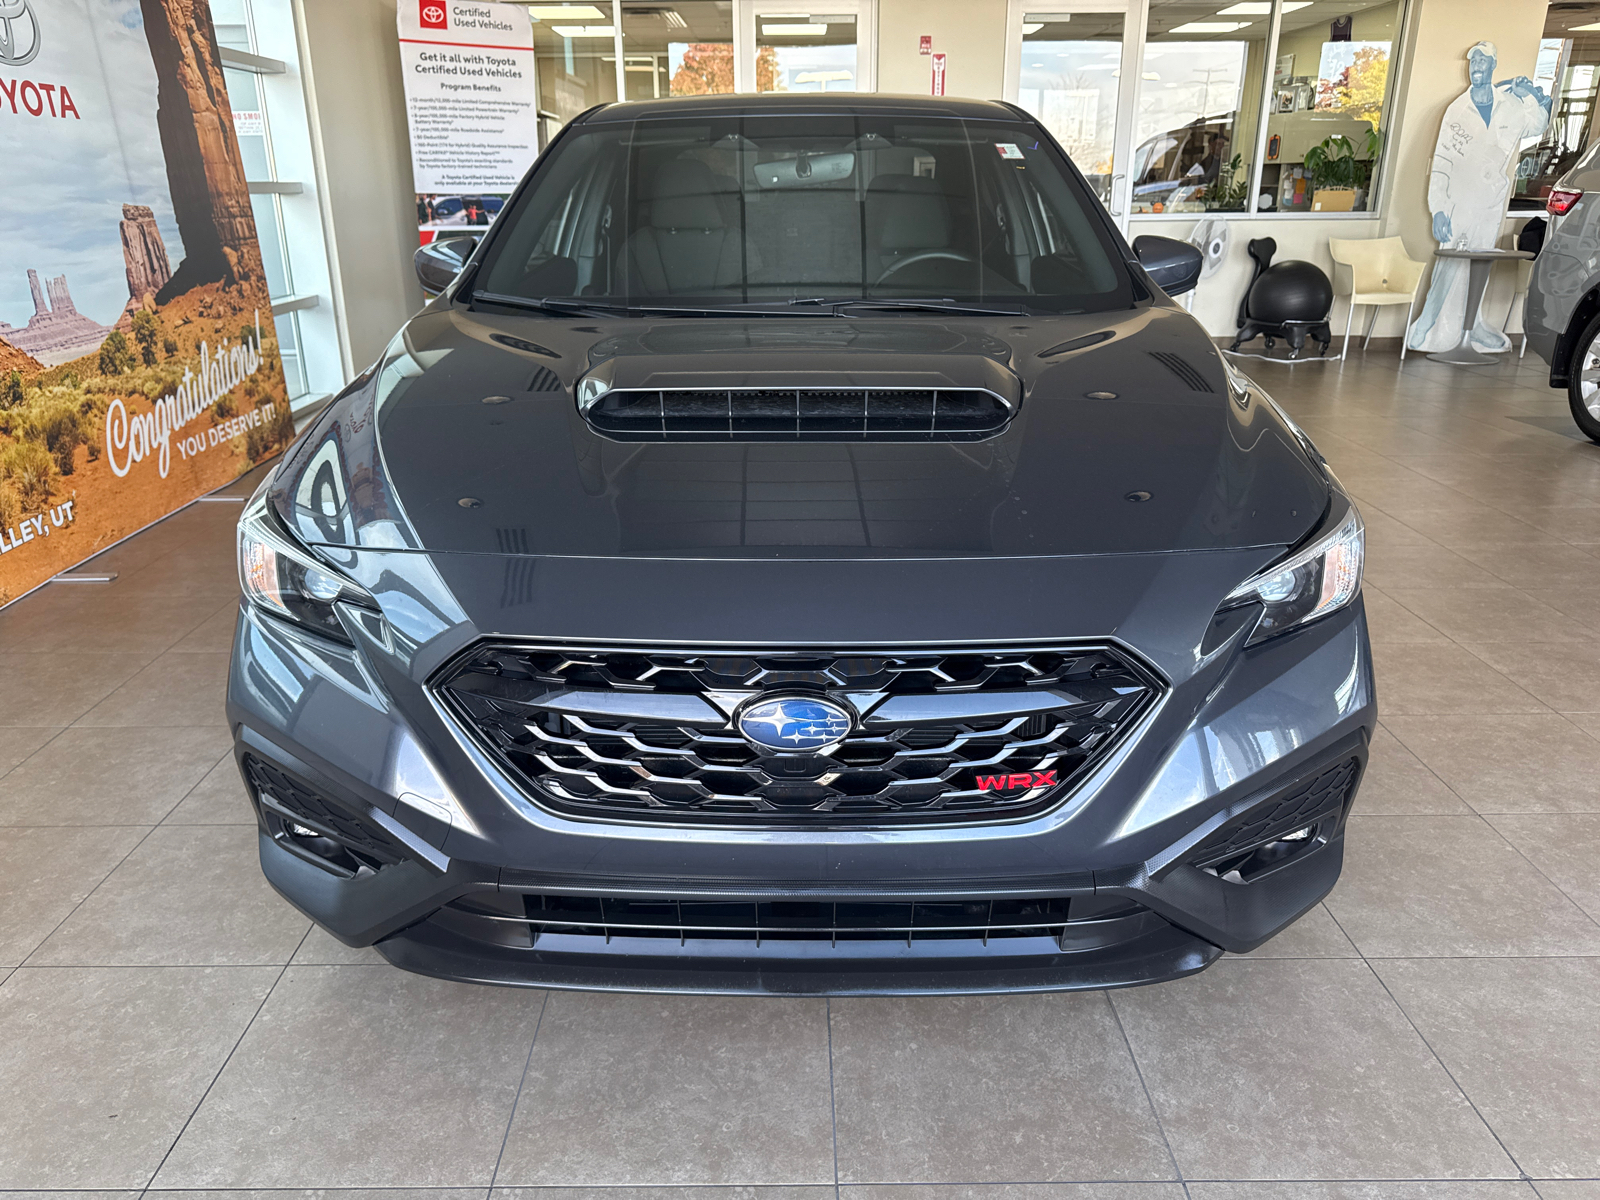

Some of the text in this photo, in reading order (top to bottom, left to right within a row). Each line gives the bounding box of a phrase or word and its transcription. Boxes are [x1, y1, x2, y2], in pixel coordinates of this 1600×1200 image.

[453, 7, 490, 18] Certified
[454, 18, 513, 30] Used Vehicles
[420, 52, 516, 67] Get it all with Toyota
[415, 65, 522, 78] Certified Used Vehicles
[440, 83, 472, 92] Program
[0, 78, 80, 120] YOTA
[106, 308, 264, 479] Congratulations!
[176, 402, 276, 460] YOU DESERVE IT!
[0, 500, 73, 555] LLEY, UT
[976, 769, 1058, 790] WRX
